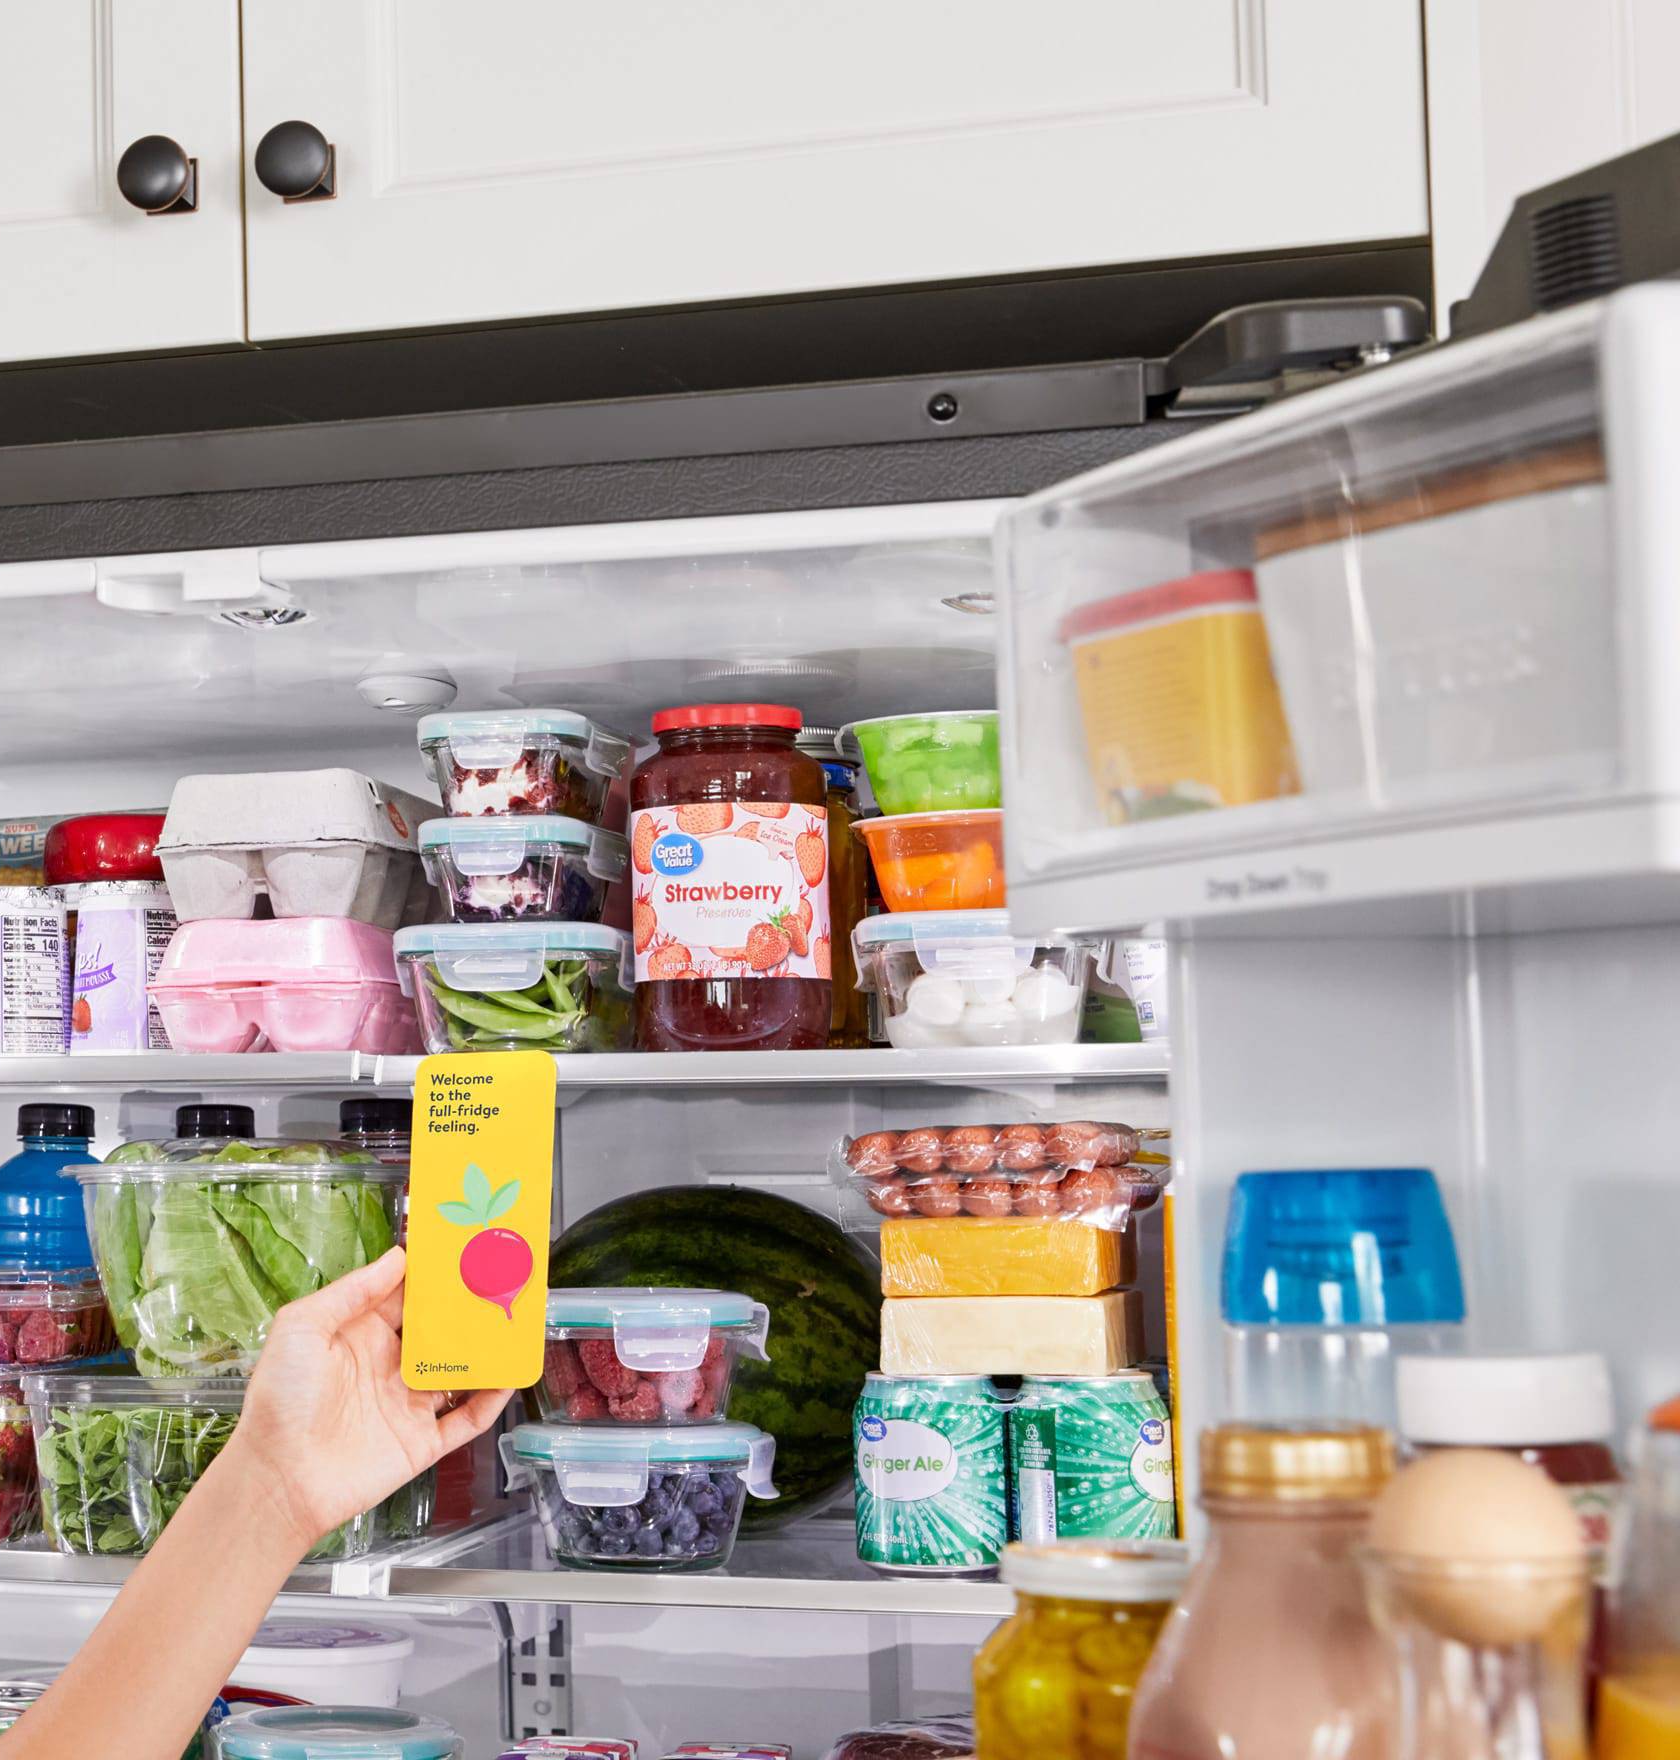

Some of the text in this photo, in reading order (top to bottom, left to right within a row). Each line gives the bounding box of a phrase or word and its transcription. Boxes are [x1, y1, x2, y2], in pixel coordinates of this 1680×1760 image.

[4, 823, 37, 833] SUPER
[759, 829, 794, 848] Ice Cream
[655, 843, 693, 859] Great
[663, 855, 693, 868] Value
[1245, 871, 1289, 895] Down
[664, 881, 783, 905] Strawberry
[695, 905, 753, 920] Preserves
[40, 917, 58, 928] Facts
[42, 939, 59, 952] 140
[663, 963, 674, 971] NET
[677, 963, 686, 971] WT
[732, 960, 752, 970] 907g
[430, 1072, 494, 1086] Welcome
[429, 1088, 471, 1101] to the
[428, 1103, 500, 1119] full-fridge
[427, 1119, 481, 1135] feeling.
[429, 1362, 469, 1373] InHome
[862, 1453, 945, 1474] Ginger Ale
